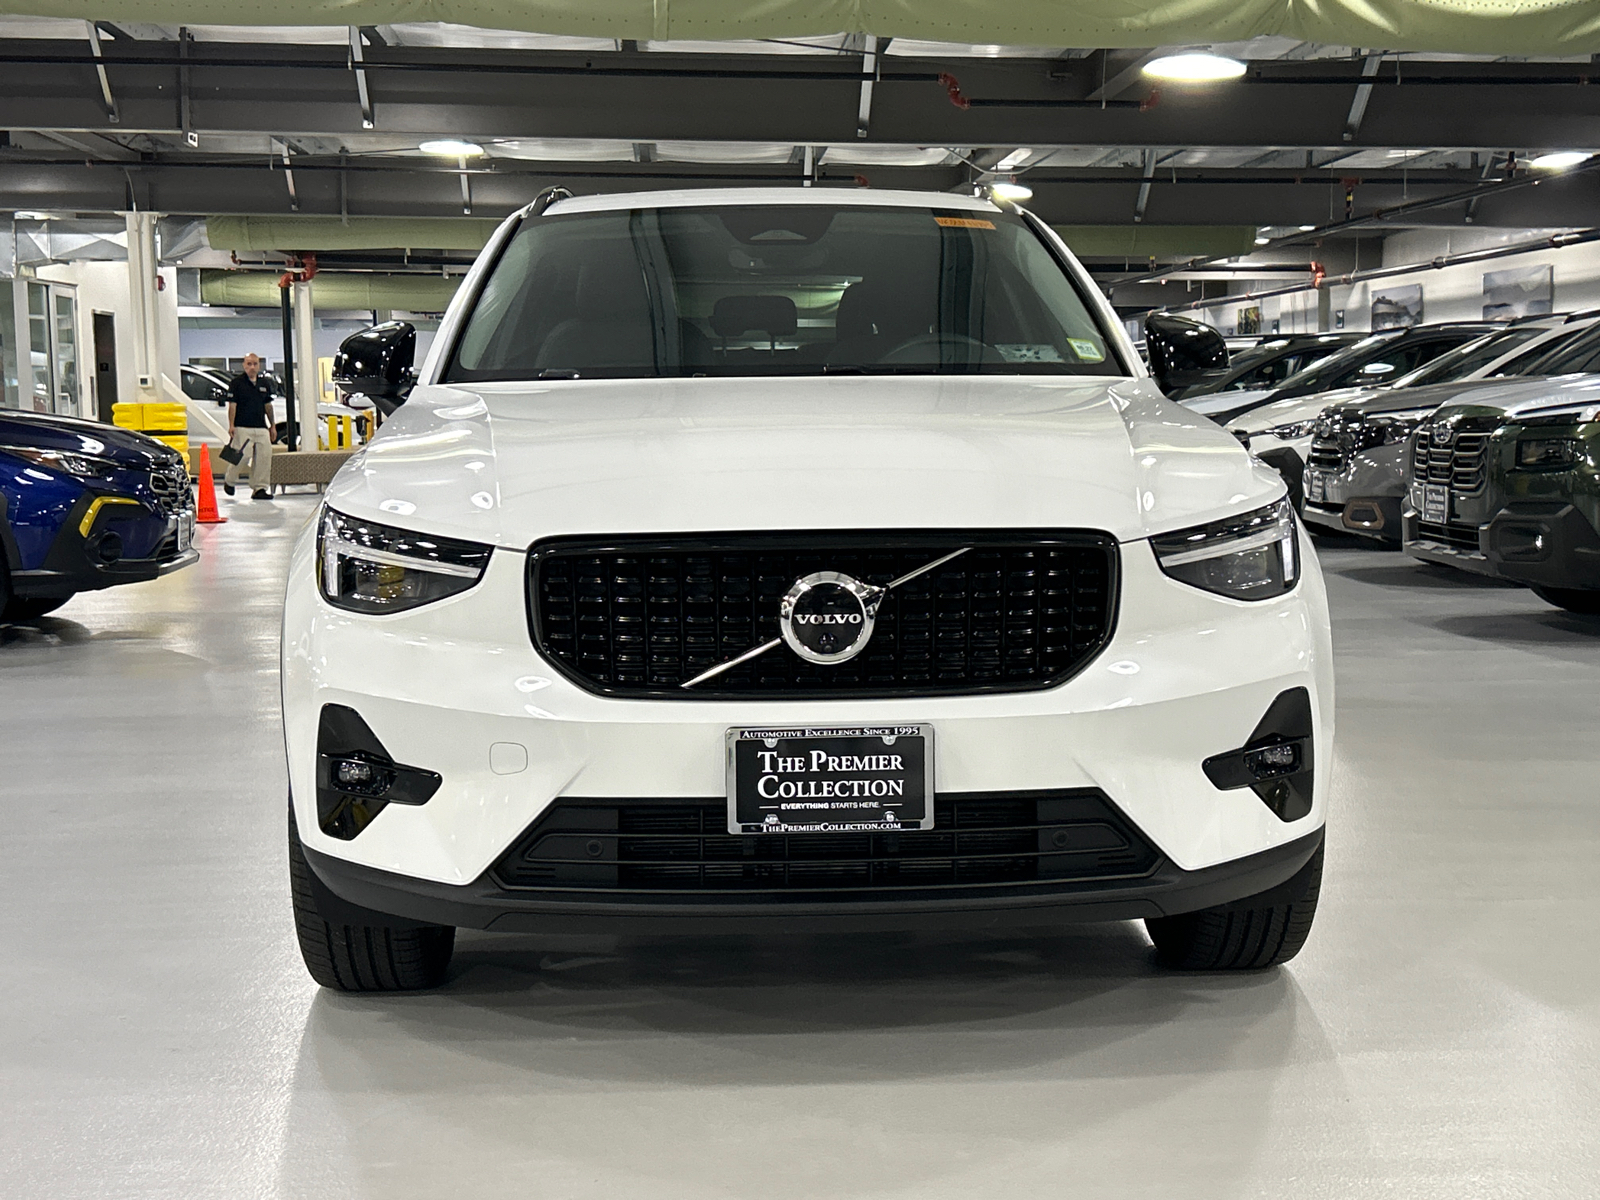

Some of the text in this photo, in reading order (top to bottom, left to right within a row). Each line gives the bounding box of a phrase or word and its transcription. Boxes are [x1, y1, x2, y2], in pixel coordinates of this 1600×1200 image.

[794, 613, 861, 624] VOLVO
[742, 726, 919, 739] AUTOMOTIVE EXCELLENCE SINCE 1995
[757, 750, 904, 773] THE PREMIER
[757, 775, 905, 799] COLLECTION
[780, 802, 829, 810] EVERYTHING
[760, 822, 902, 833] THEPREMIERCOLLECTION.COM
